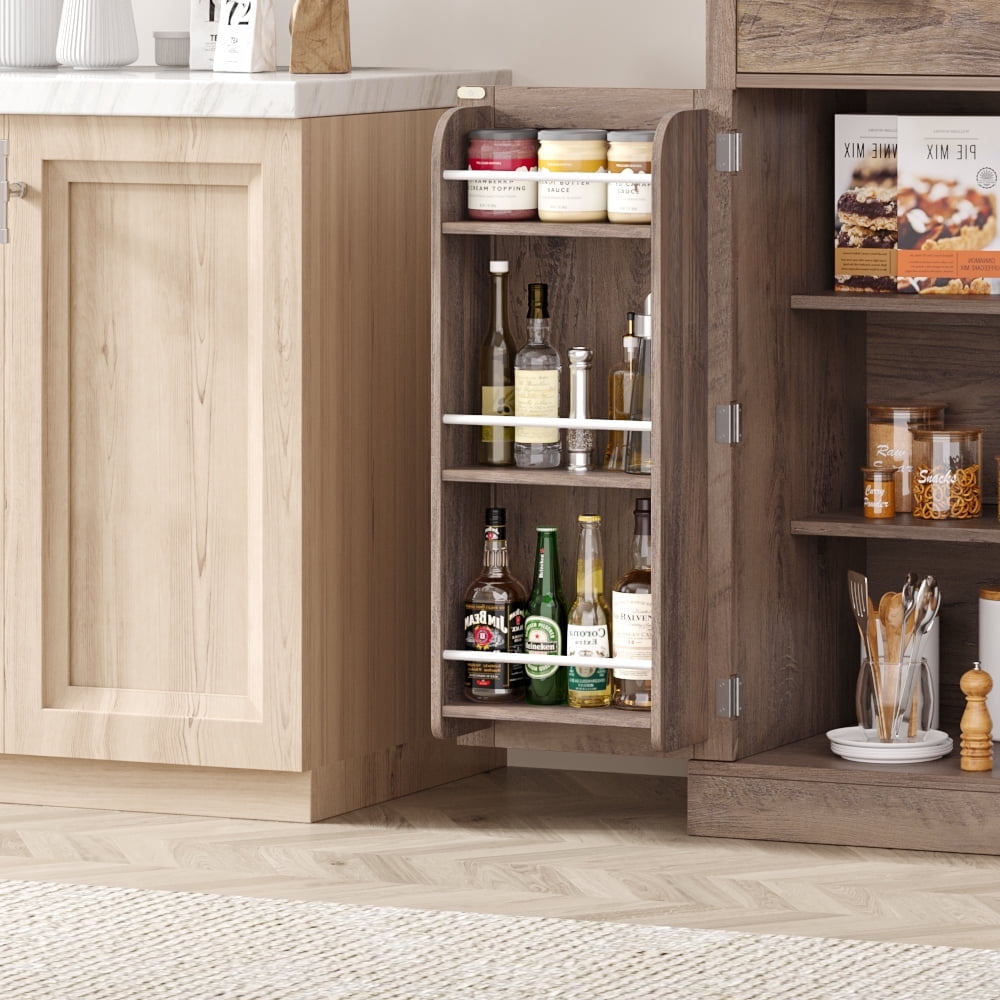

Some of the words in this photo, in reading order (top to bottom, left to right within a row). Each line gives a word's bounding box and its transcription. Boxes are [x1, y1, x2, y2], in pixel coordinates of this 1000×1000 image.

[226, 0, 251, 25] 72
[876, 444, 905, 457] Raw
[918, 469, 957, 484] Snacks
[620, 613, 652, 621] BALVEN
